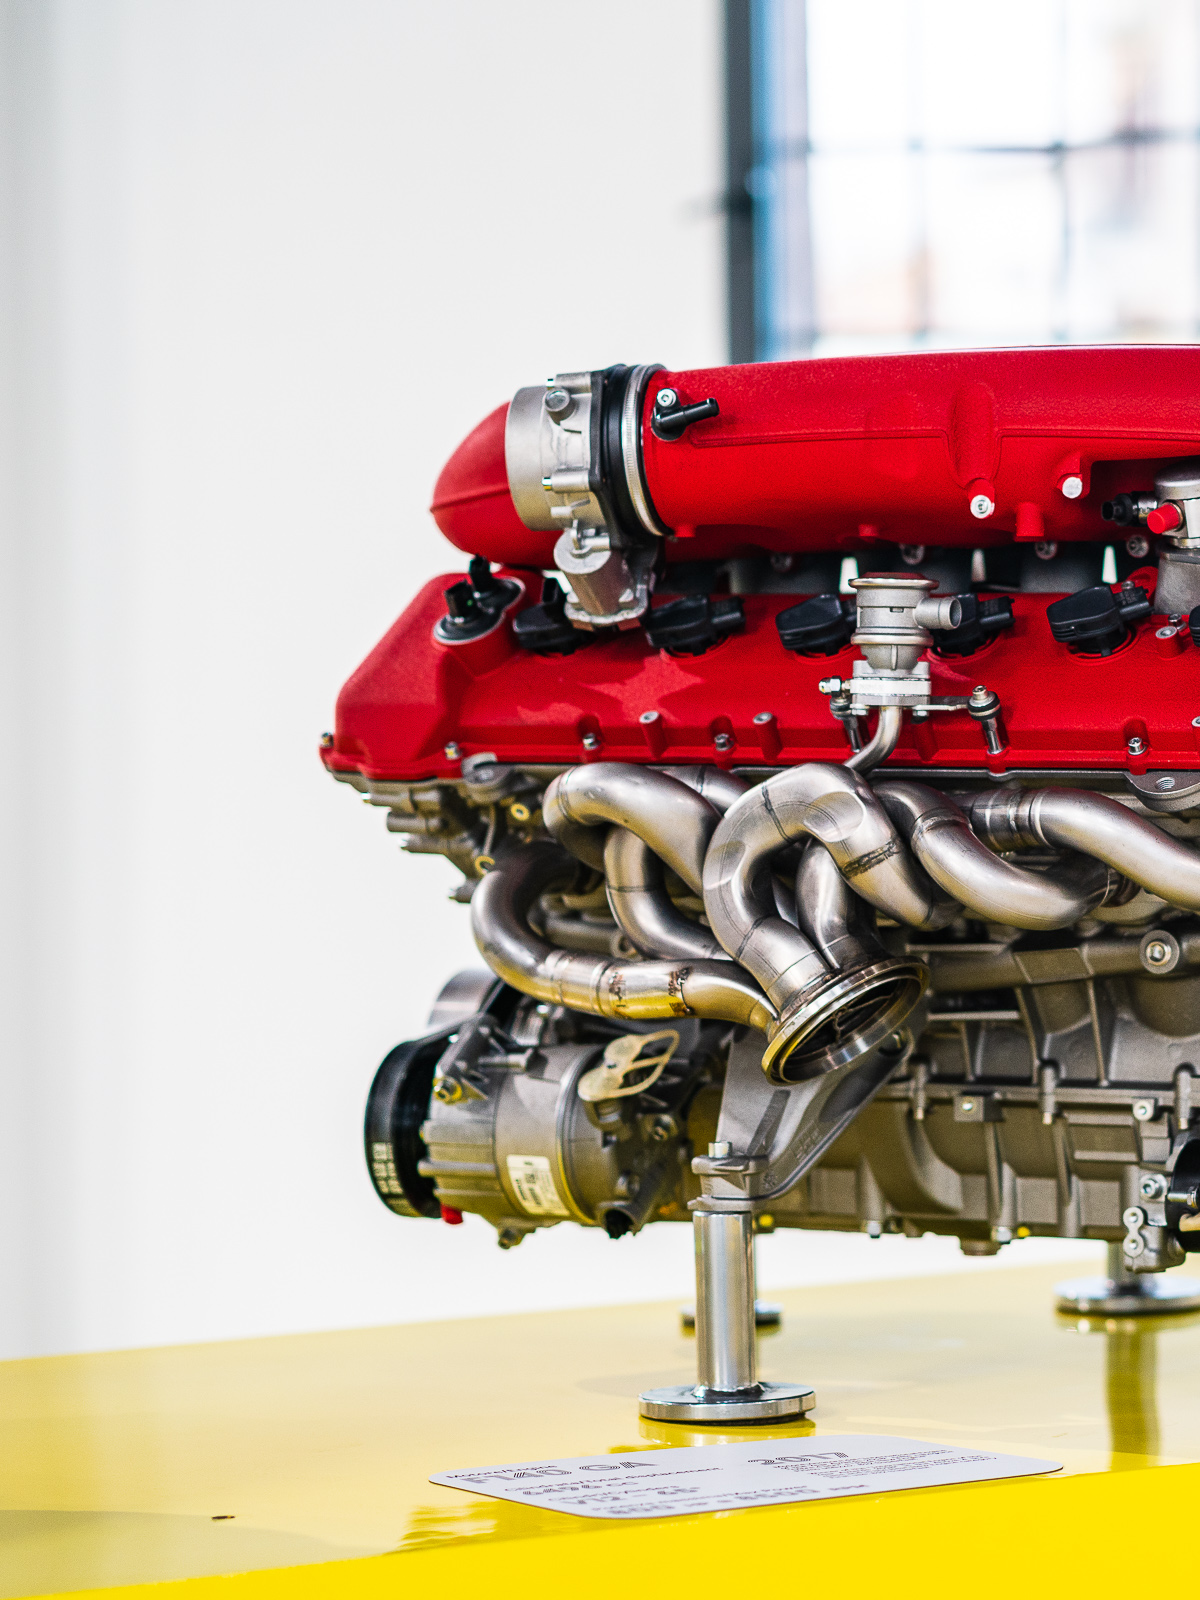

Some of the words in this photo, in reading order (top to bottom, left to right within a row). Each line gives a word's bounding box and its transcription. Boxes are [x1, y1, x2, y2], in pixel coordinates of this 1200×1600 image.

[748, 1452, 848, 1465] 2017
[461, 1470, 572, 1484] F140
[579, 1461, 659, 1470] GA
